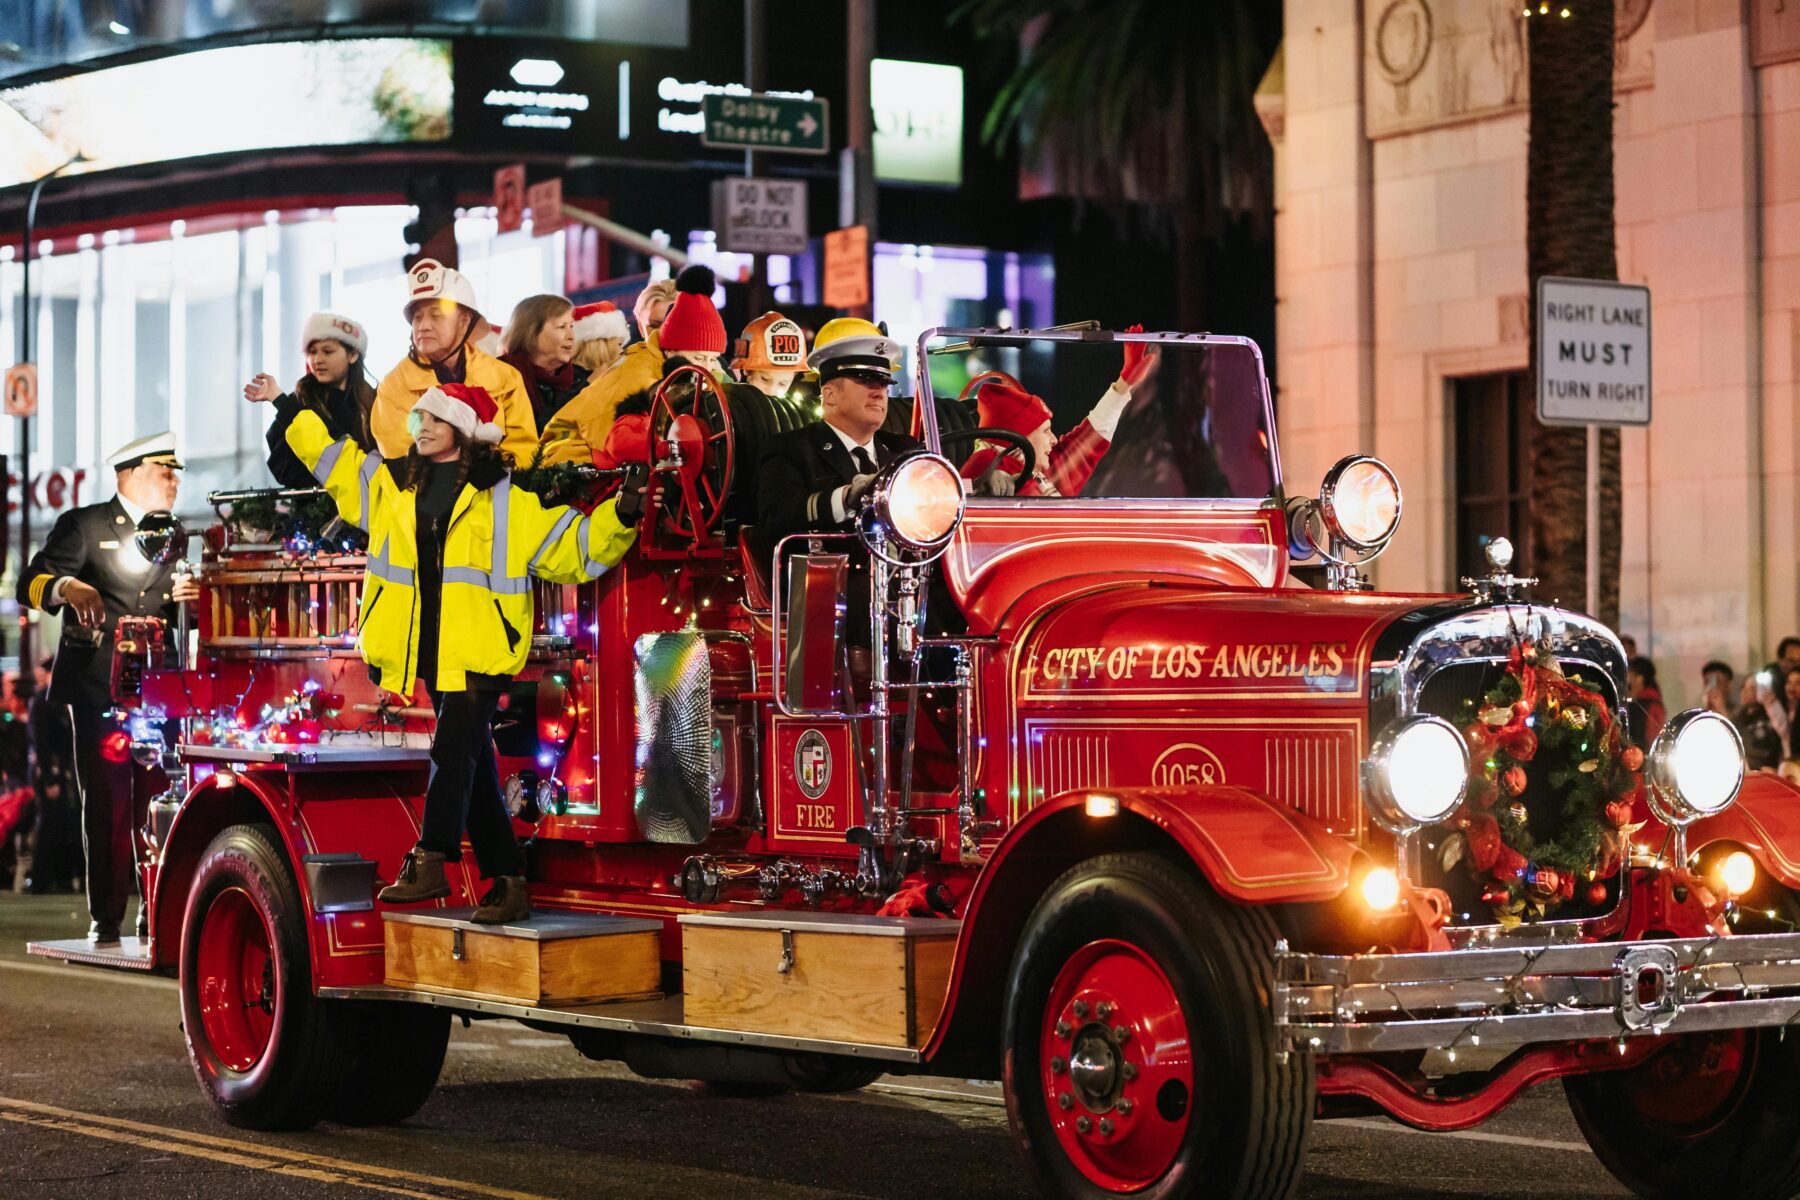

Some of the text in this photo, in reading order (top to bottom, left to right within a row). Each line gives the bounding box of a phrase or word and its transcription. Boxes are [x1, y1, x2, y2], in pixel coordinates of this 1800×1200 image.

[722, 98, 780, 124] Dolby
[712, 120, 792, 144] Theatre
[736, 183, 794, 207] DO NOT
[740, 207, 792, 229] BLOCK
[1547, 302, 1645, 328] RIGHT LANE
[773, 335, 799, 353] PIO
[1559, 340, 1632, 365] MUST
[1547, 379, 1646, 403] TURN RIGHT
[1043, 643, 1347, 680] CITY OF LOS ANGELES
[1160, 763, 1215, 785] 1058
[796, 804, 835, 829] FIRE
